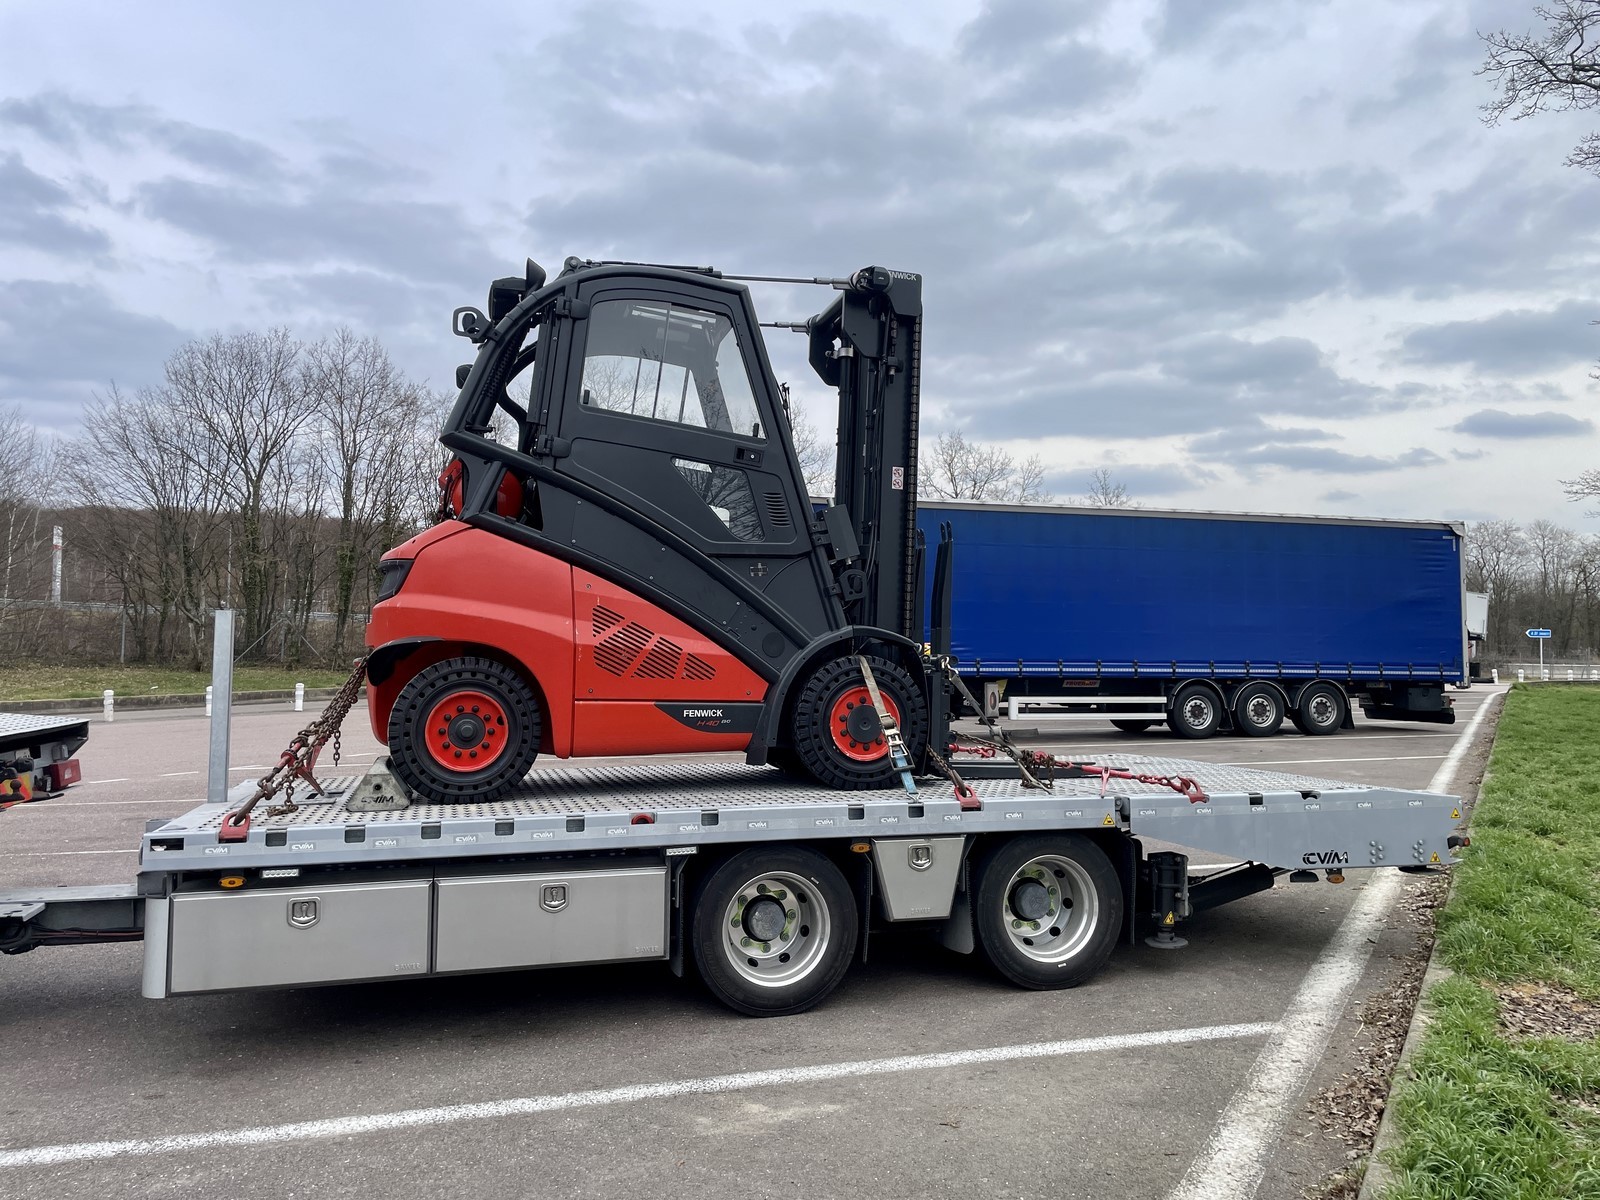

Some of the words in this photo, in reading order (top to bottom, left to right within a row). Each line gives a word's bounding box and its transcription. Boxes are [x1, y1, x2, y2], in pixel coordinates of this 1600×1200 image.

[889, 271, 917, 281] NWICK
[683, 709, 723, 718] FENWICK
[1302, 849, 1350, 865] CVIM
